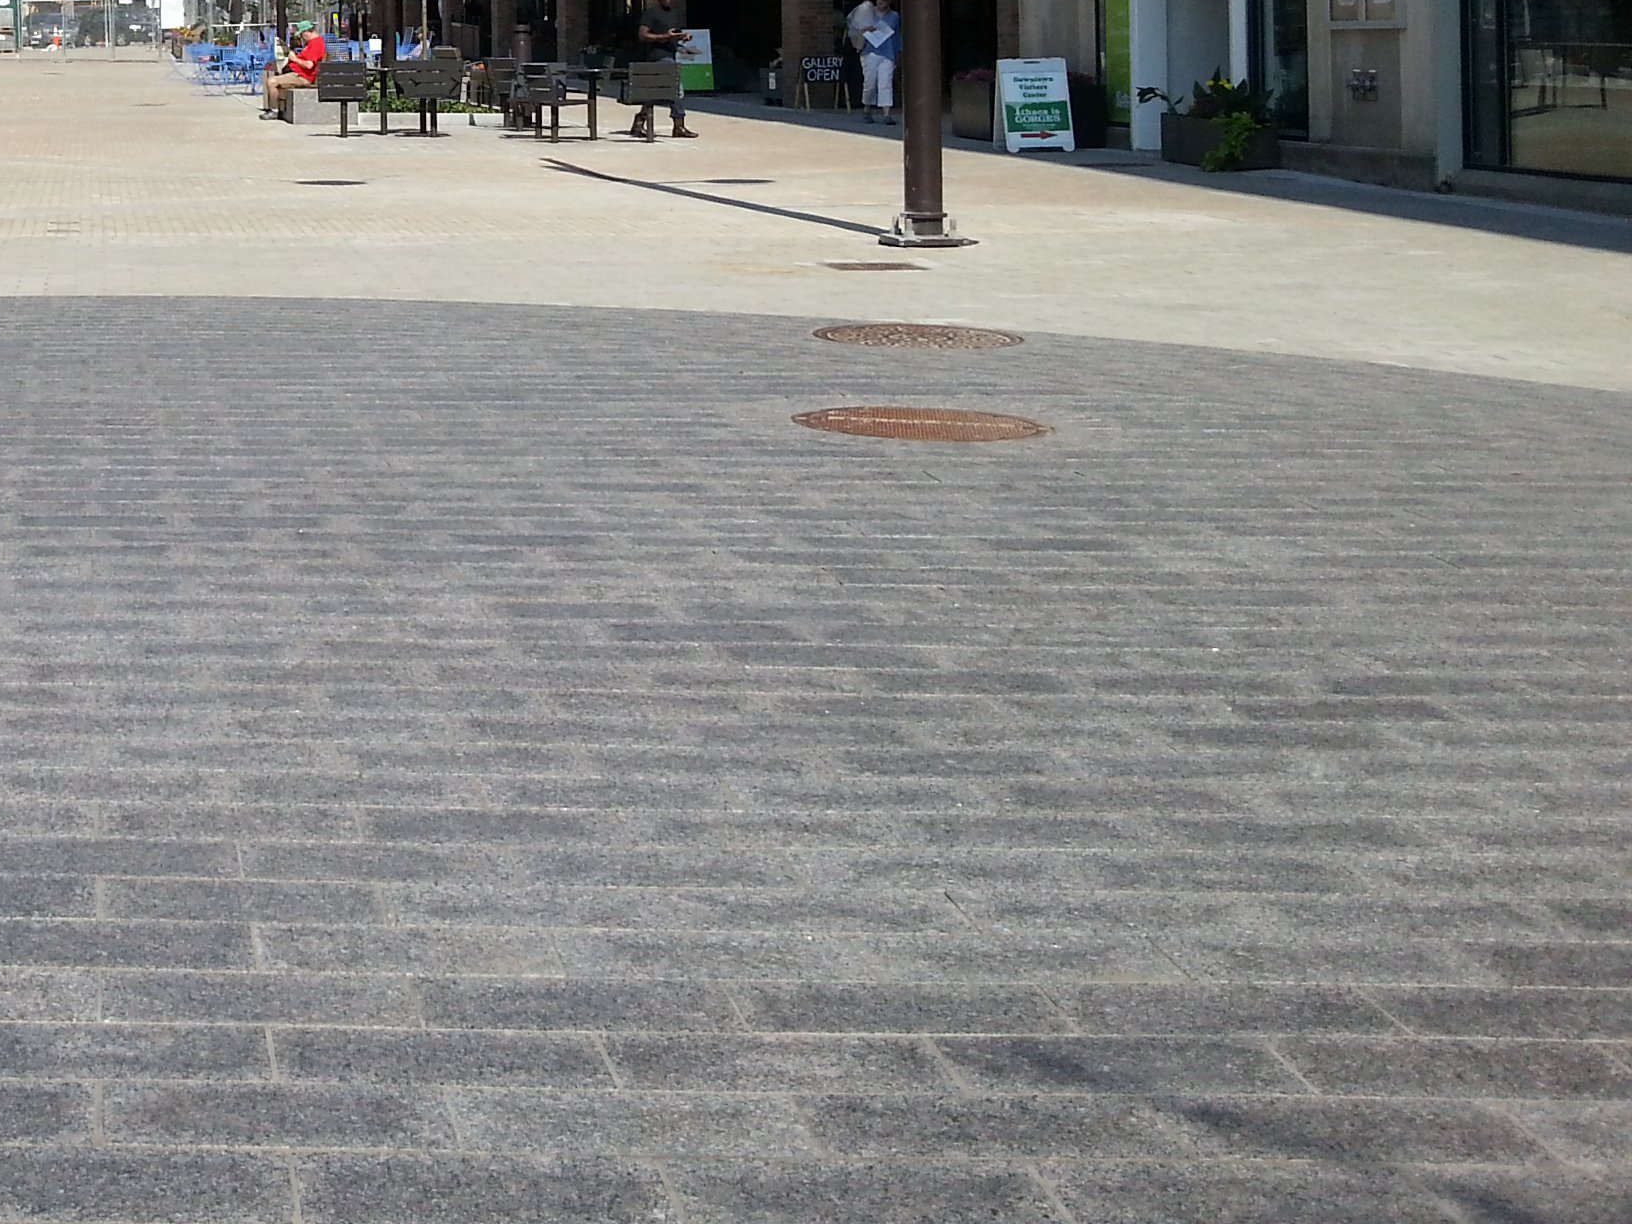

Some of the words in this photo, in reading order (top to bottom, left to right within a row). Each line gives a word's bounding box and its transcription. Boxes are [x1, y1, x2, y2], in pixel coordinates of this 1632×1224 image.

[802, 57, 844, 70] GALLERY
[807, 69, 840, 81] OPEN
[1014, 106, 1048, 116] Ithaca
